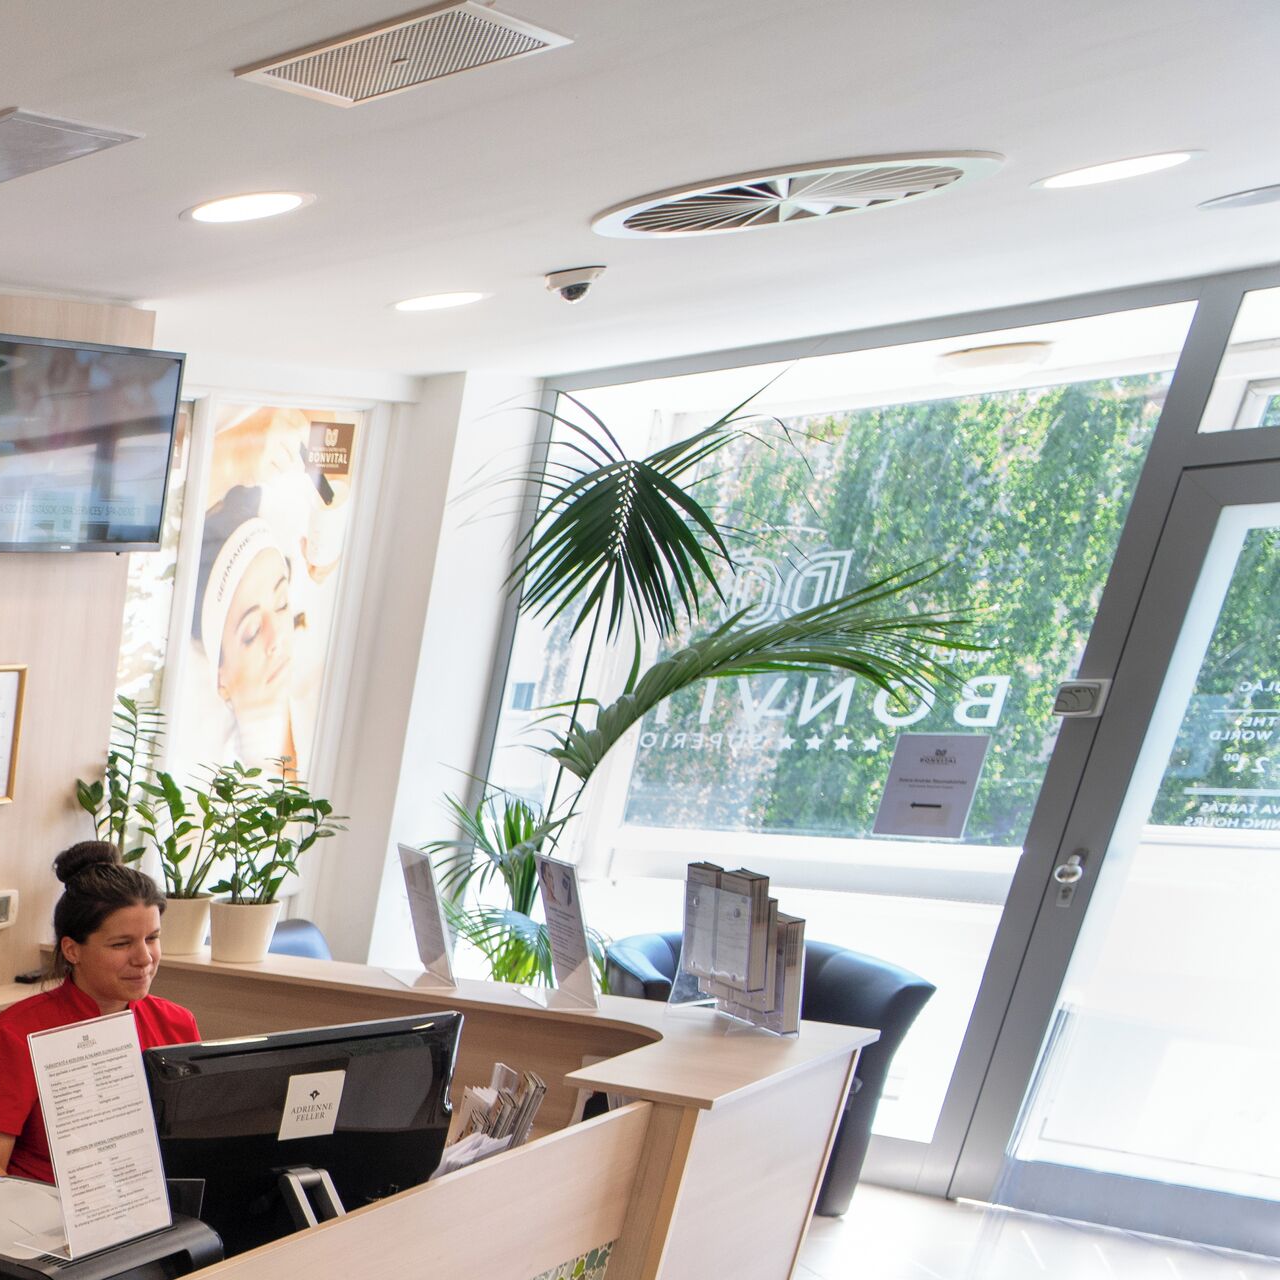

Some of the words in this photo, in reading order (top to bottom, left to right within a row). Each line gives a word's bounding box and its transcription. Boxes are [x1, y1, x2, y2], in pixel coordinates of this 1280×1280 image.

[308, 451, 348, 464] BONVITAL
[291, 1102, 334, 1115] ADRIENNE
[296, 1112, 325, 1122] FELLER
